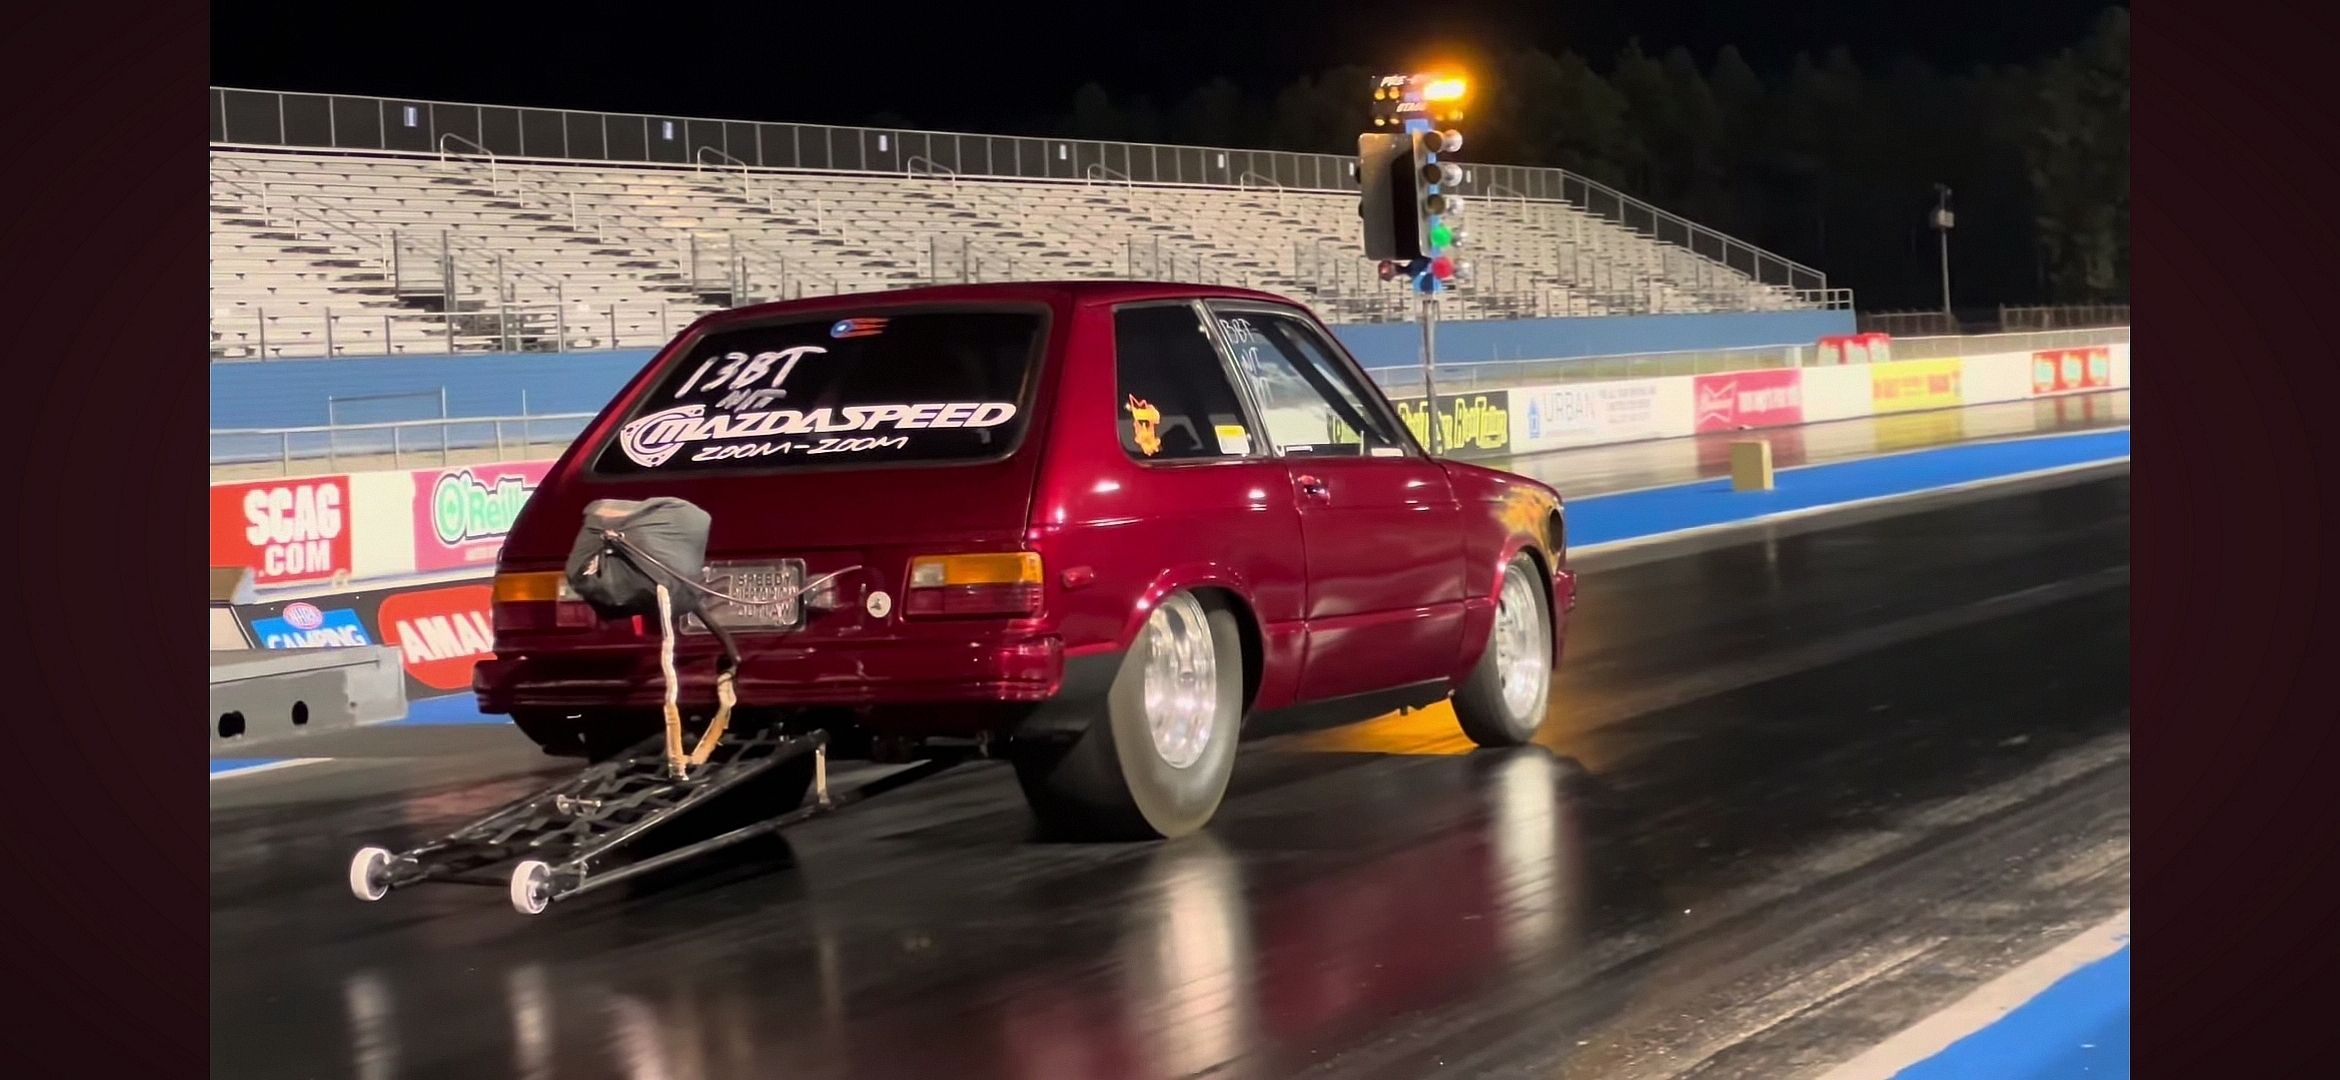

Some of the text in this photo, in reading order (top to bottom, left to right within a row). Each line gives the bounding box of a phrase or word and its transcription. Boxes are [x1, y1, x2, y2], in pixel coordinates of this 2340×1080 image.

[674, 346, 828, 399] 13BT
[643, 403, 1017, 446] MAZDASPEED
[691, 436, 908, 462] ZOOM-ZOOM
[243, 483, 341, 546] SCAG
[436, 478, 530, 537] O'Reill
[257, 539, 331, 578] .COM
[738, 572, 791, 586] SPEEDY
[395, 610, 493, 664] AMAL
